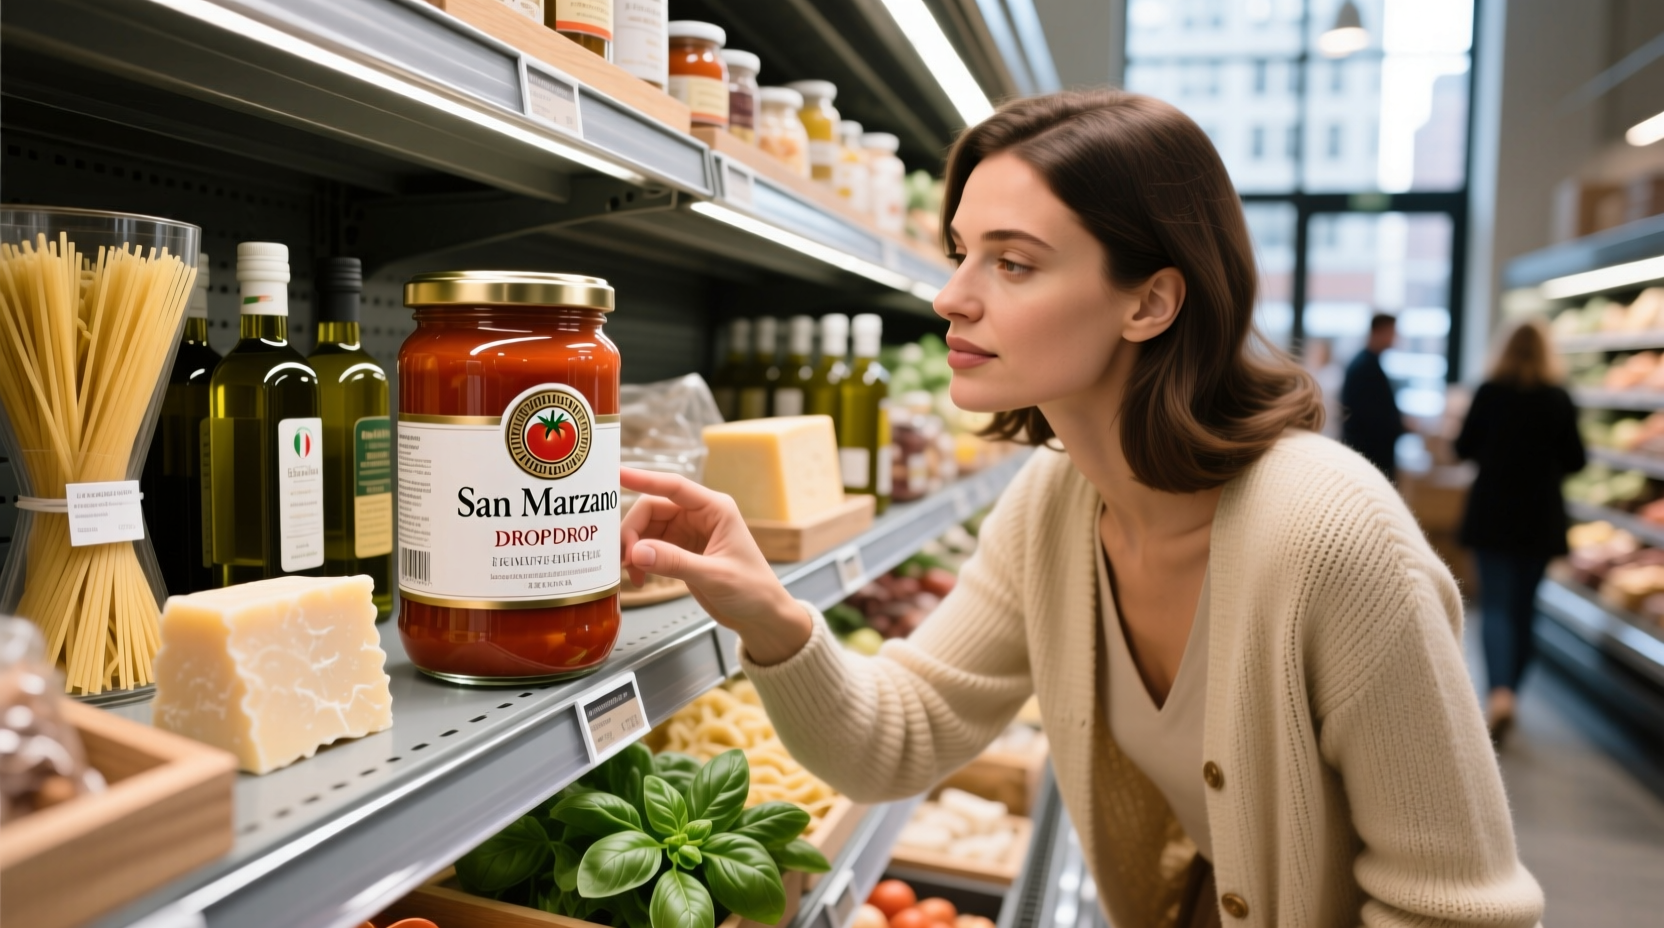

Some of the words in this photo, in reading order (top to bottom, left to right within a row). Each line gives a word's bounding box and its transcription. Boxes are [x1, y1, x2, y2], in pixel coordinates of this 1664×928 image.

[457, 486, 511, 518] San
[521, 487, 618, 517] Marzano
[494, 525, 598, 547] DROPDROP
